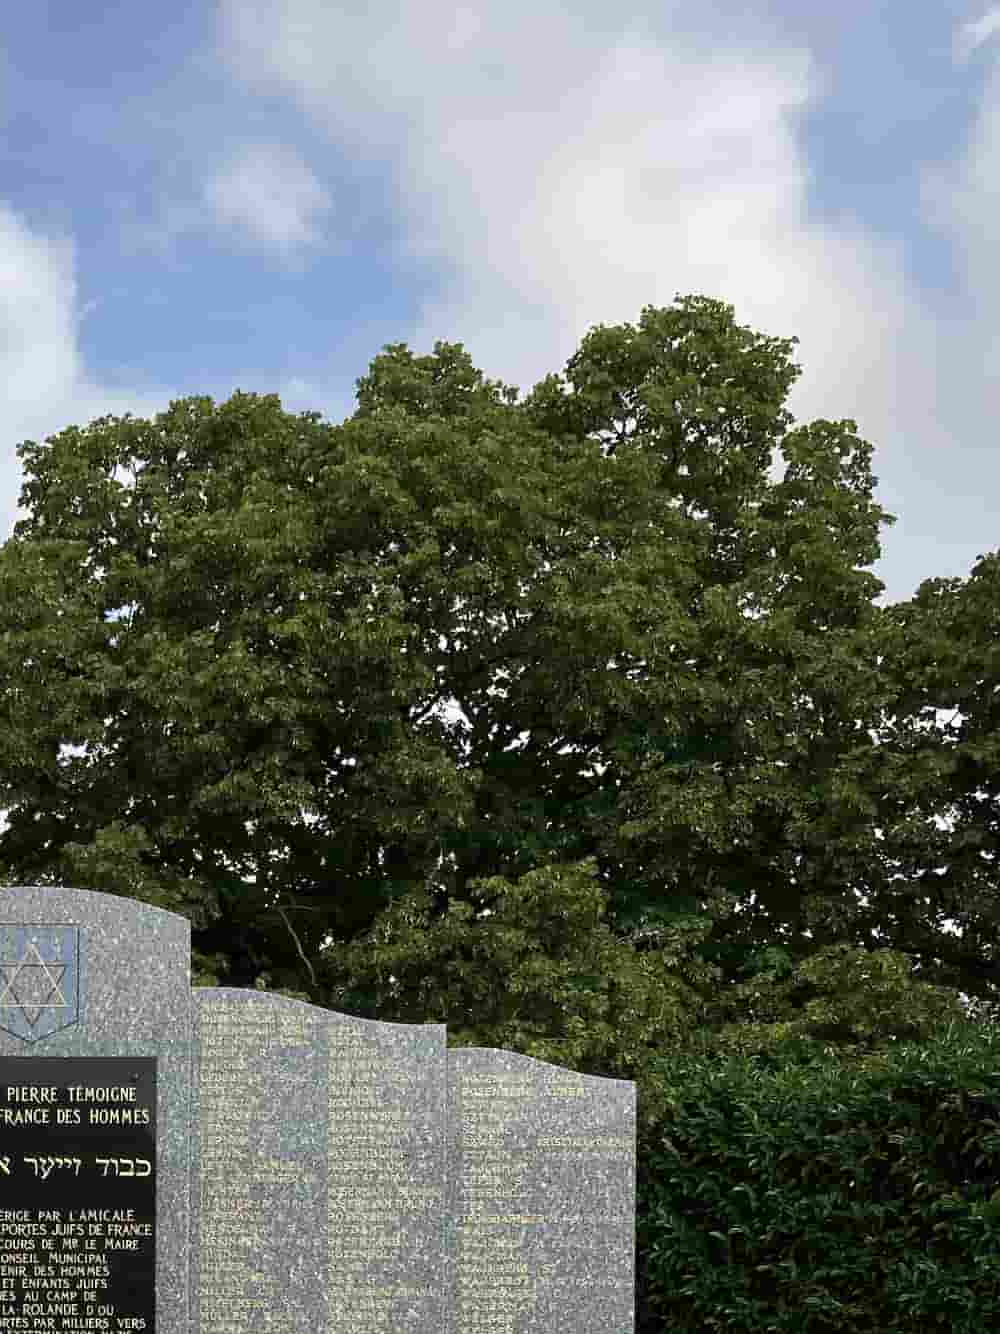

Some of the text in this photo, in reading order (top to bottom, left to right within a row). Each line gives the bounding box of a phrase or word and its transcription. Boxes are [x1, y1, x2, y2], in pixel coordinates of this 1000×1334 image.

[7, 1086, 59, 1104] PIERRE
[56, 1109, 81, 1124] DES
[89, 1108, 150, 1124] HOMMES
[37, 1210, 61, 1223] PAR
[50, 1223, 85, 1237] JUIFS
[88, 1223, 105, 1236] DE
[107, 1224, 153, 1237] FRANCE
[41, 1238, 55, 1251] DE
[84, 1239, 97, 1250] LE
[104, 1237, 140, 1251] MAIRE
[48, 1251, 108, 1264] MUNICIPAL
[33, 1265, 55, 1277] DES
[60, 1265, 110, 1277] HOMMES
[2, 1277, 15, 1289] ET
[21, 1277, 71, 1289] ENFANTS
[75, 1278, 108, 1290] JUIFS
[23, 1290, 39, 1302] AU
[46, 1290, 78, 1302] CAMP
[83, 1290, 97, 1302] DE
[33, 1317, 56, 1329] PAR
[61, 1317, 110, 1329] MILLIERS
[116, 1317, 147, 1331] VERS
